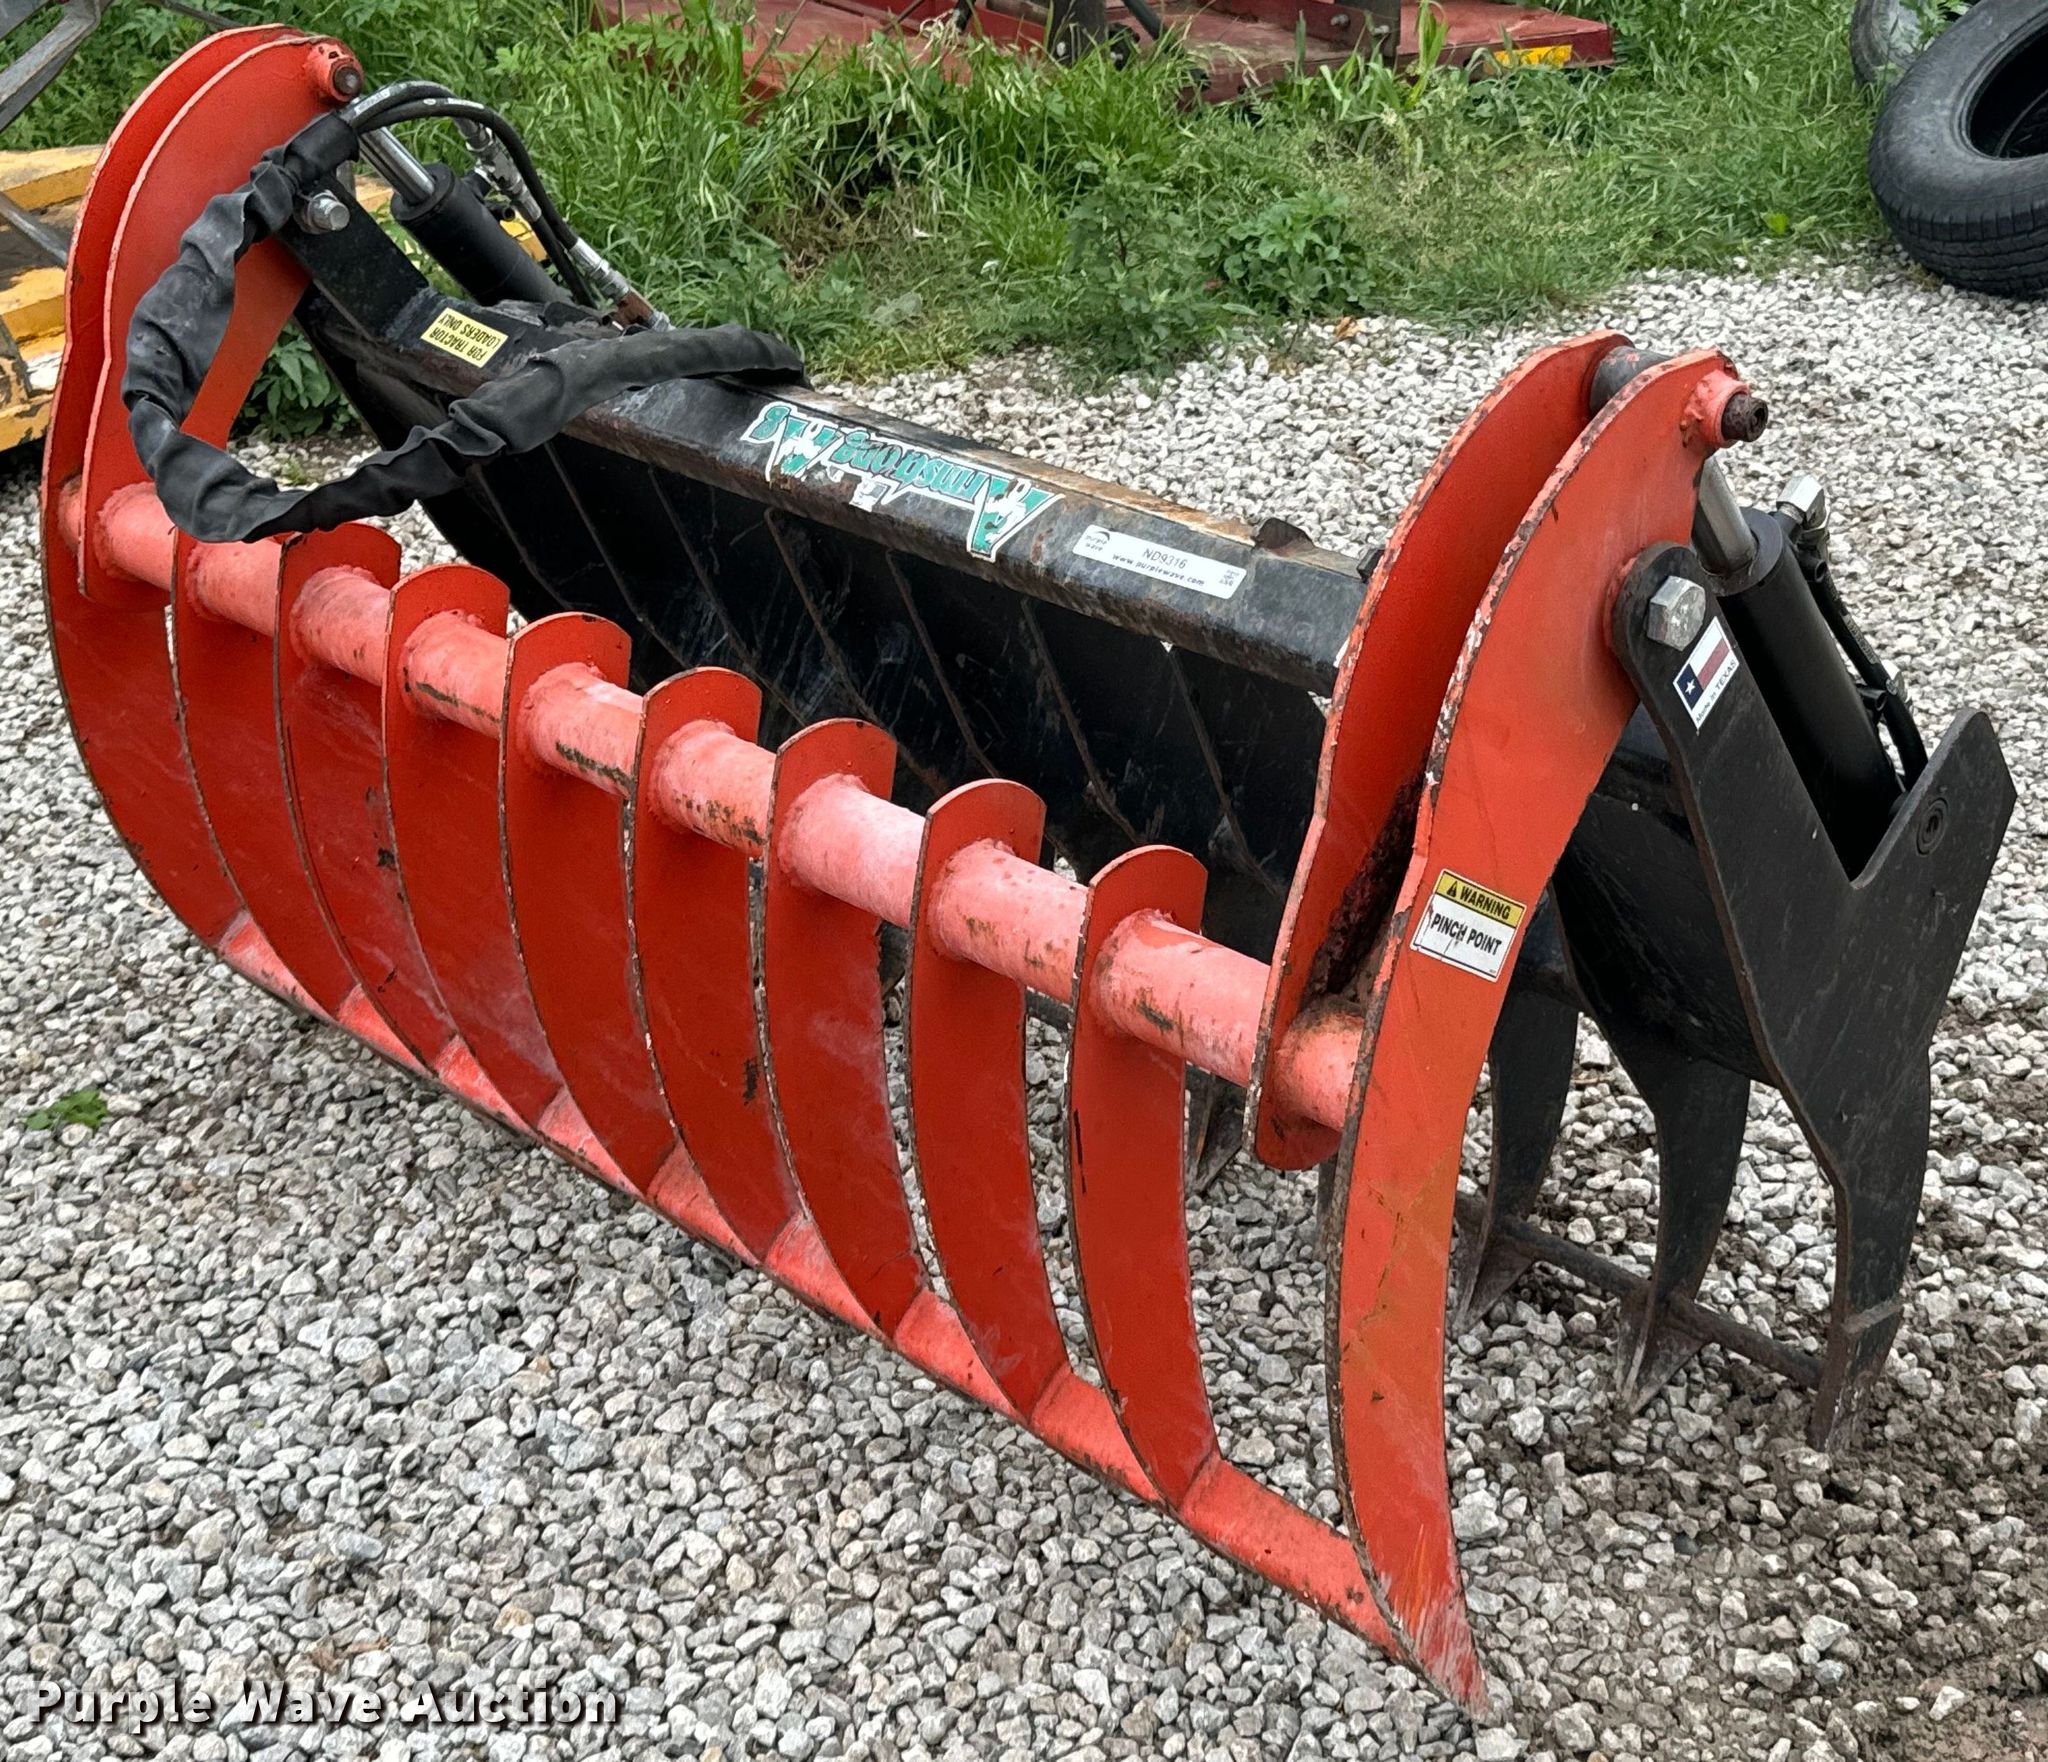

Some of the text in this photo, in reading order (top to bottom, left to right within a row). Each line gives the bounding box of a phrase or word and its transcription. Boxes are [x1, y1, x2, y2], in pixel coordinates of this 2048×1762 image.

[429, 327, 488, 361] FOR TRACTOR
[438, 313, 502, 349] LOADERS ONLY
[1142, 547, 1188, 569] ND9316
[1715, 658, 1737, 691] TEXAS
[1459, 885, 1512, 920] WARNING
[1430, 912, 1502, 956] PINCH POINT
